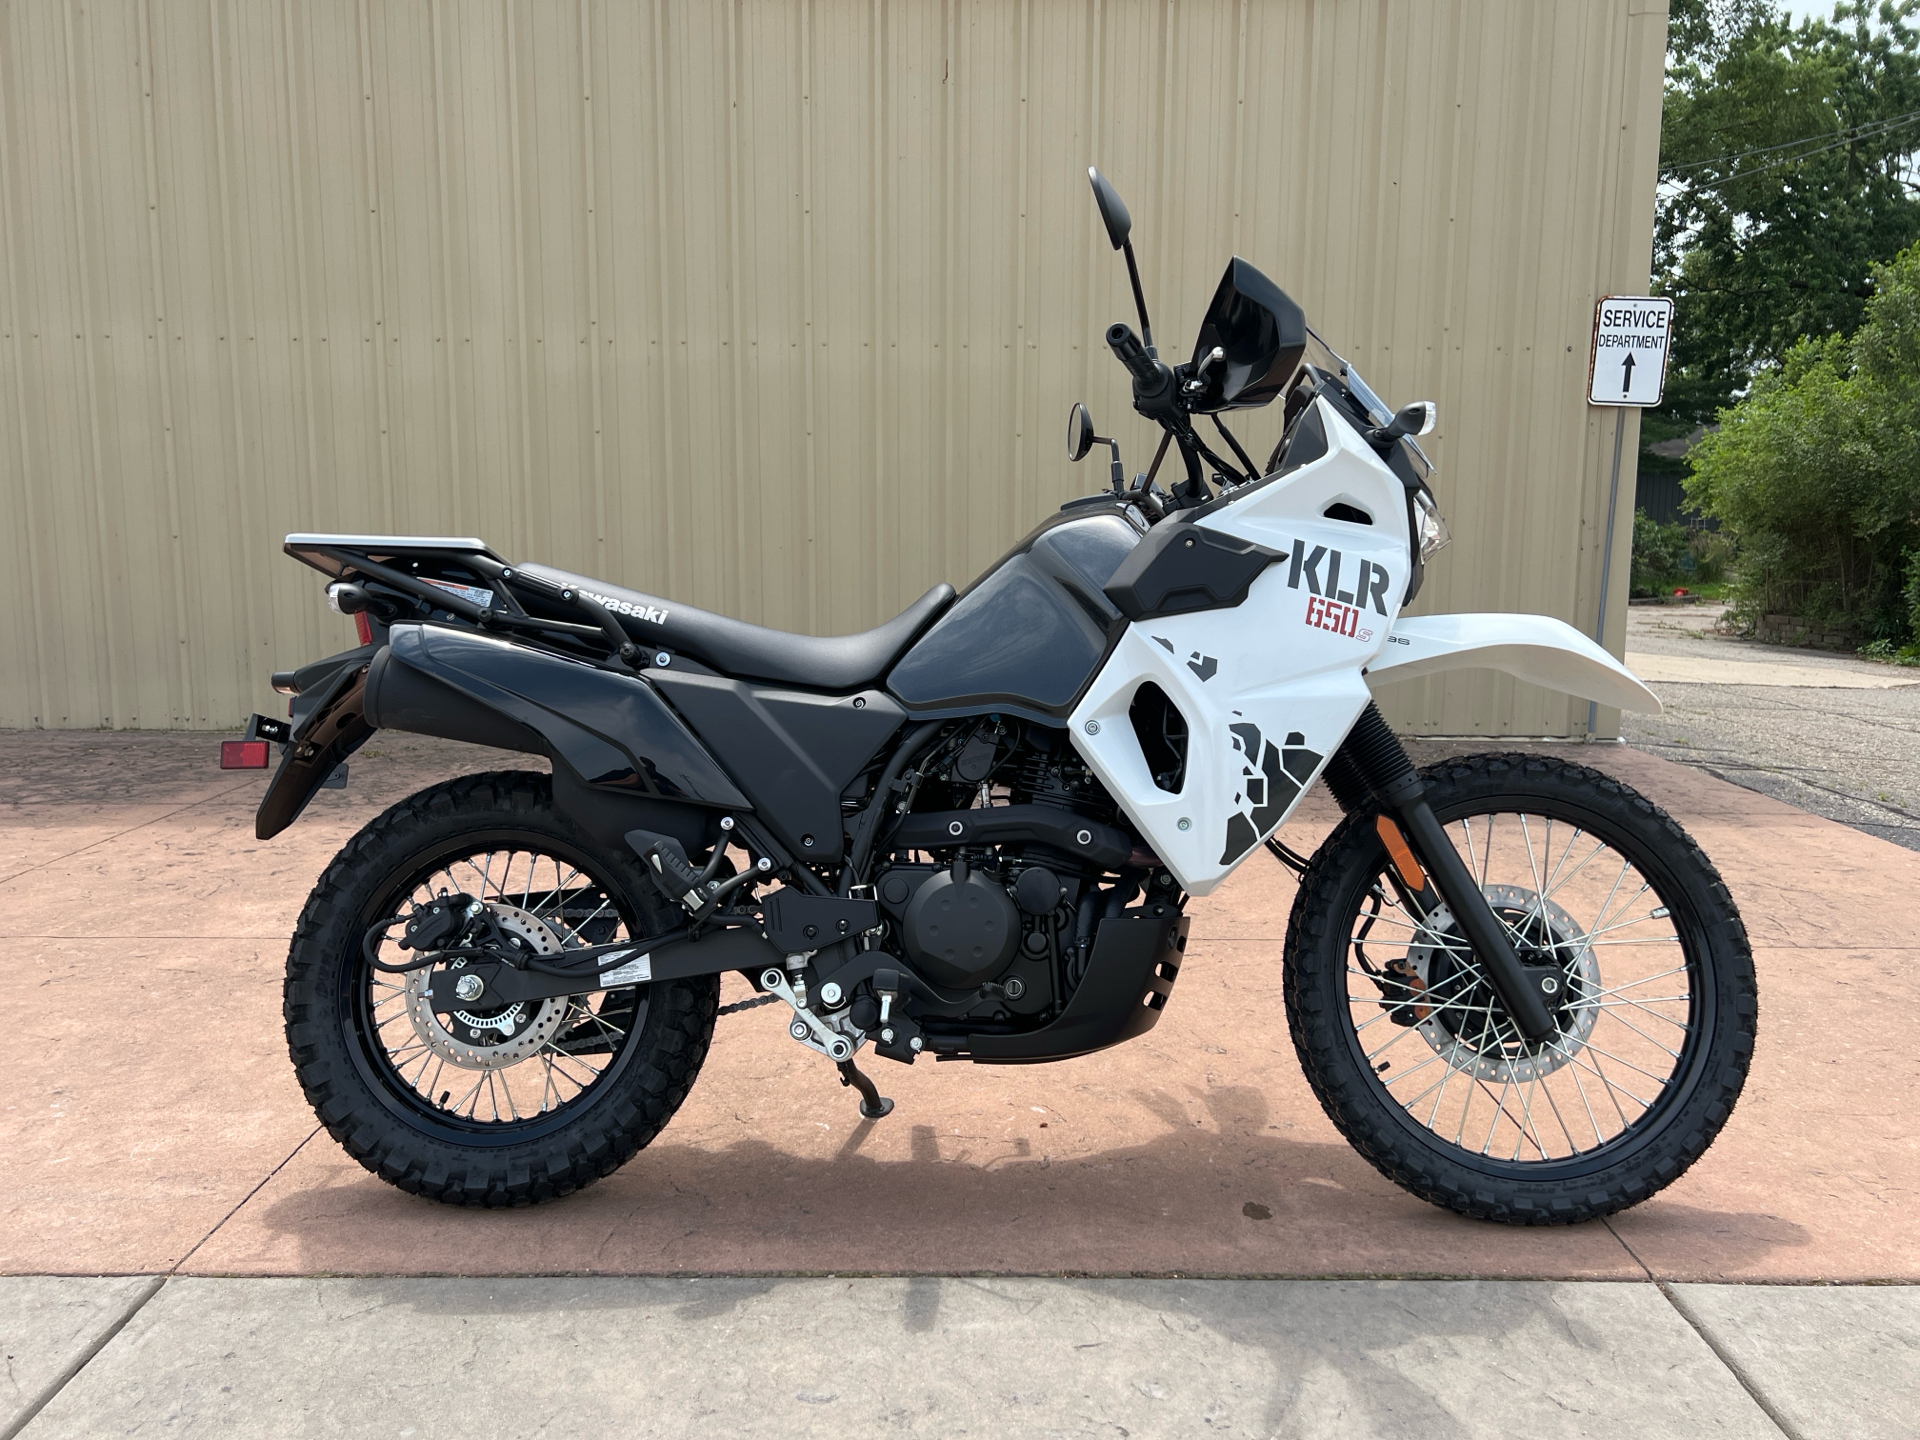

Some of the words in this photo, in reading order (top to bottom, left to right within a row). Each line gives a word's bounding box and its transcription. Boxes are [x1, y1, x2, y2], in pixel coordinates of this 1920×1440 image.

[1603, 309, 1666, 329] SERVICE
[1598, 334, 1665, 350] DEPARTMENT
[1287, 538, 1390, 617] KLR
[561, 582, 669, 625] wasaki
